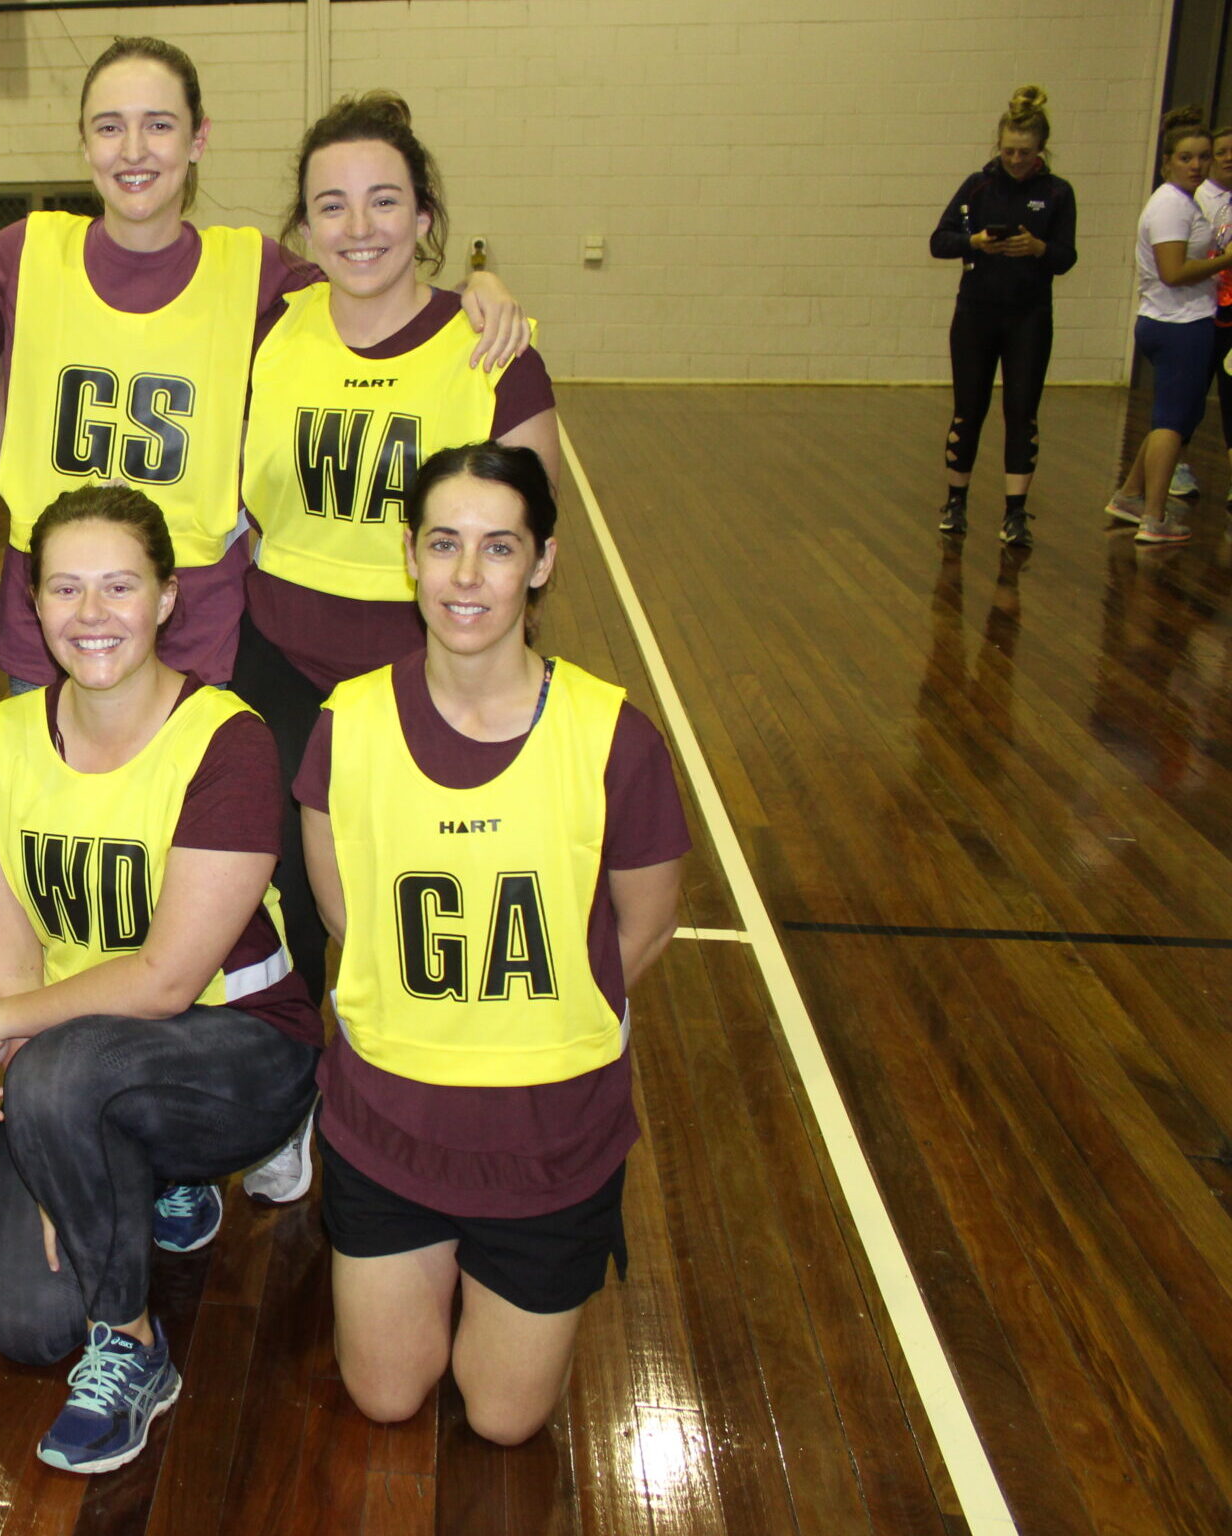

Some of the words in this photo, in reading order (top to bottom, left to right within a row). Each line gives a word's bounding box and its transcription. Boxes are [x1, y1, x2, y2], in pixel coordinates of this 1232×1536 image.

[51, 364, 195, 485] GS
[344, 378, 399, 388] HART
[294, 407, 423, 523] WA
[439, 818, 502, 834] HART
[20, 829, 154, 952] WD
[394, 871, 559, 1003] GA
